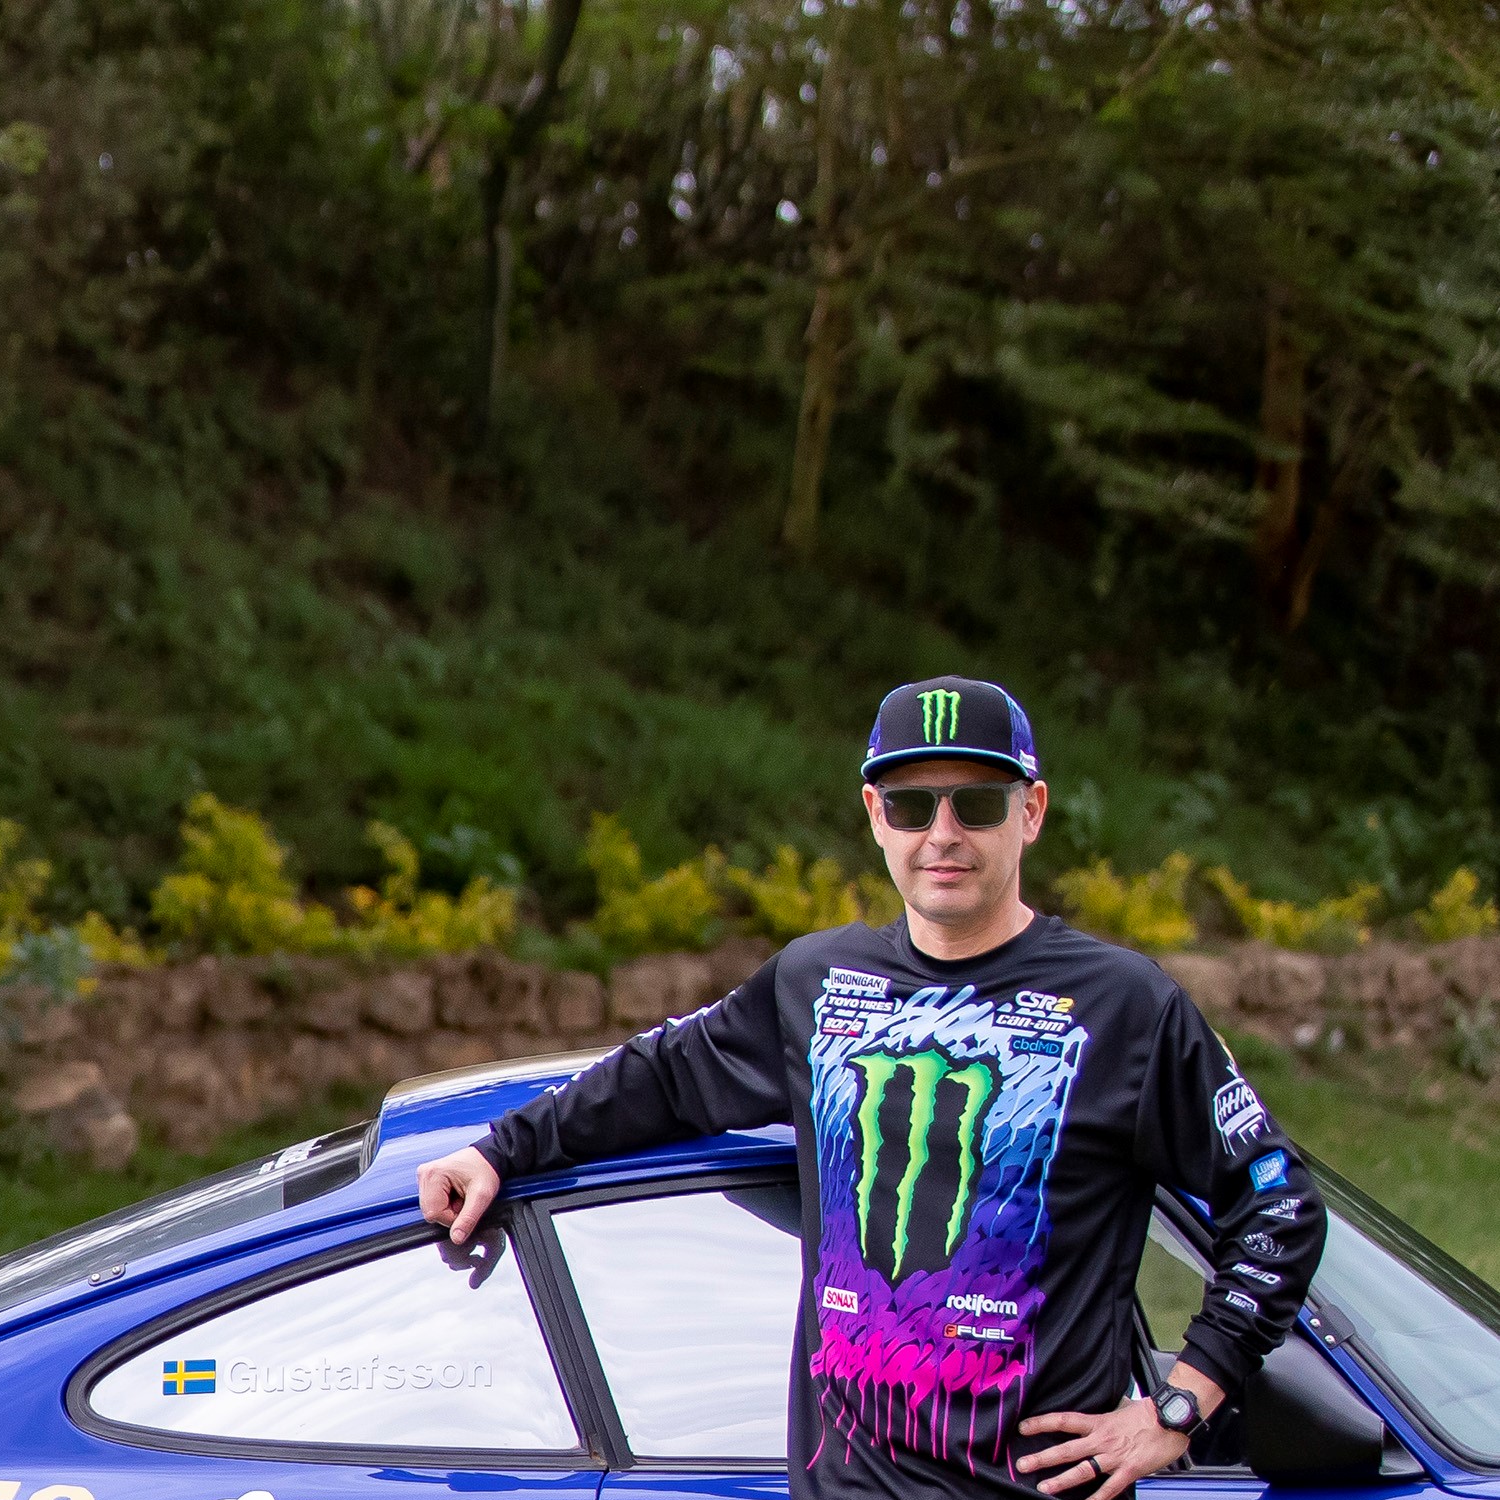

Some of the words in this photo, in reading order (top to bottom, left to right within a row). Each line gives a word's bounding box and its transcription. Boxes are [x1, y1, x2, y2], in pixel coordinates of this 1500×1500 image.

[828, 996, 859, 1009] TOYO
[859, 999, 894, 1012] TIRES
[1015, 990, 1074, 1013] CSR2
[996, 1014, 1065, 1032] can-am
[1012, 1039, 1060, 1055] cbdMD
[826, 1290, 855, 1310] SONAX
[946, 1294, 1018, 1317] rotiform
[957, 1327, 1014, 1341] FUEL
[225, 1354, 493, 1393] Gustafsson
